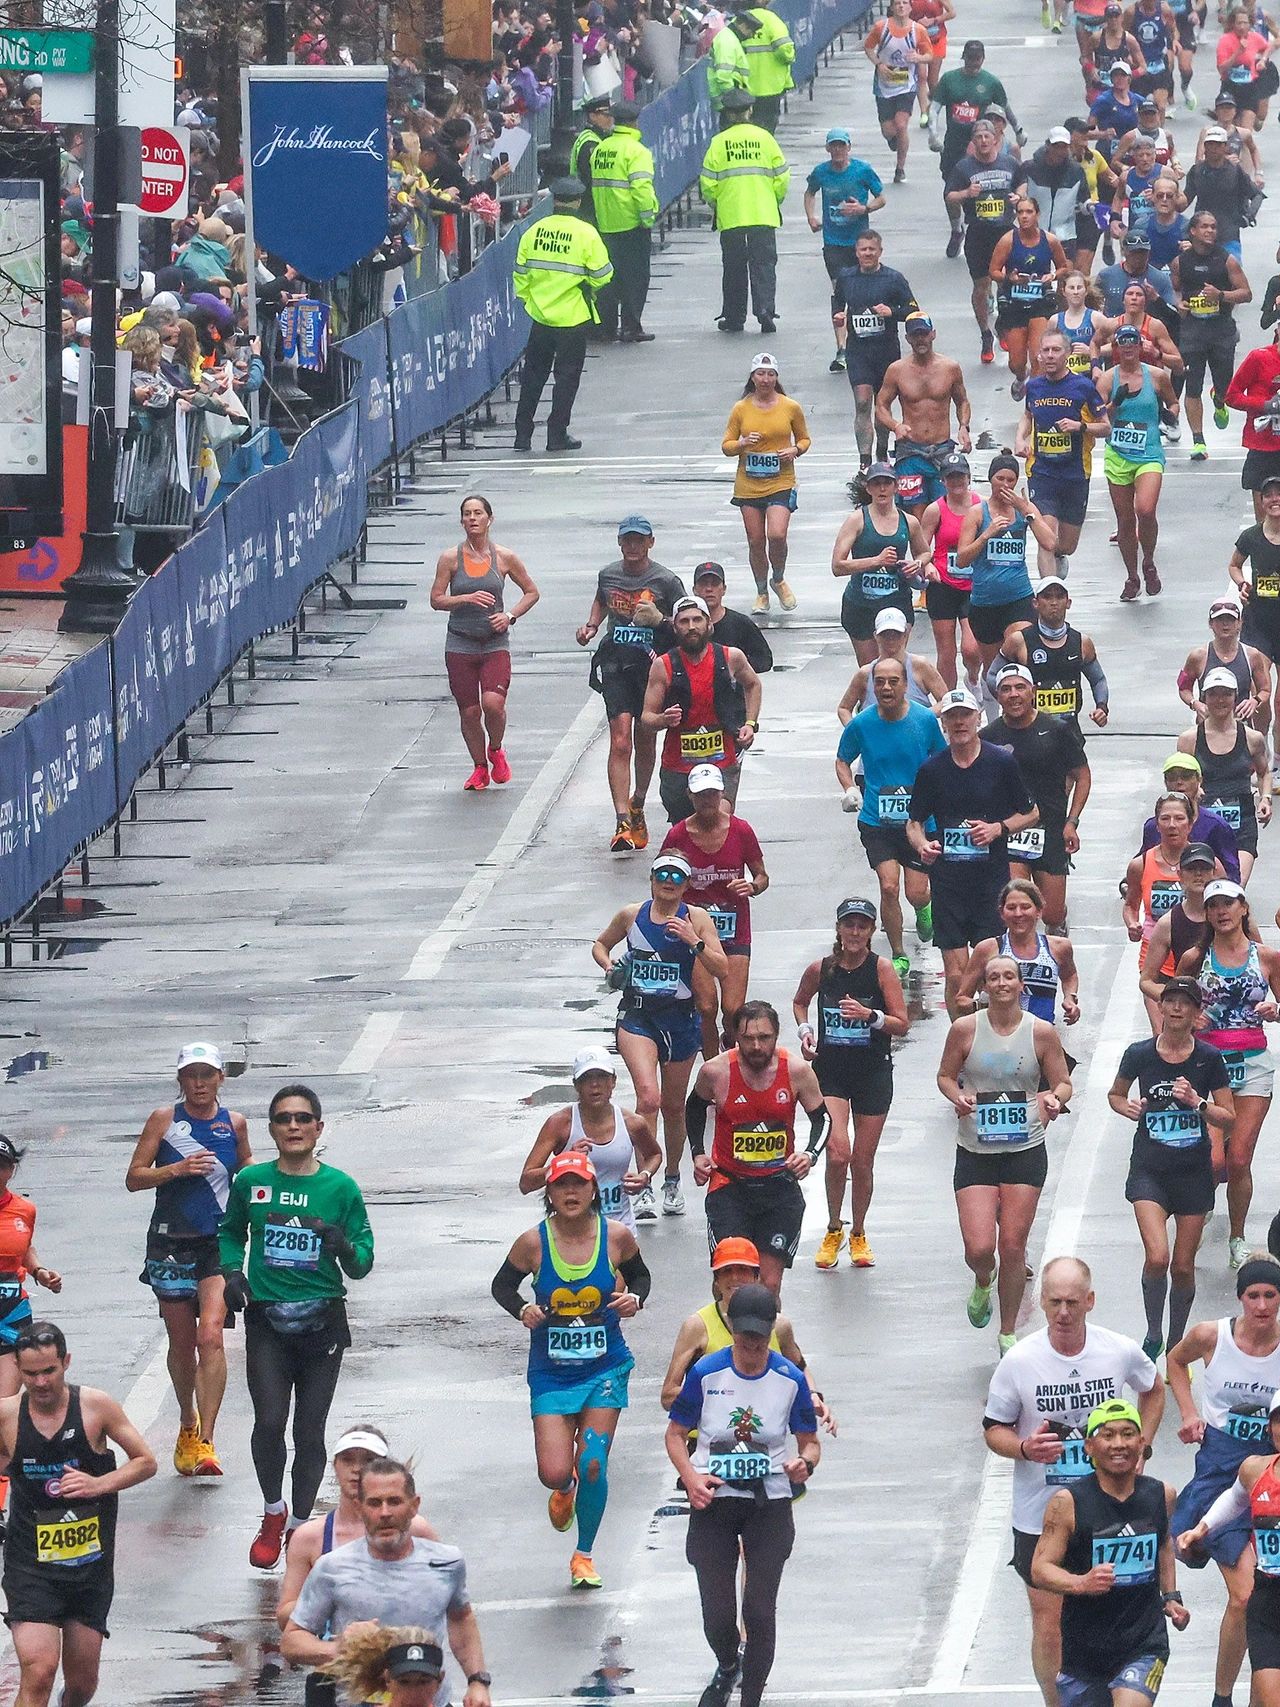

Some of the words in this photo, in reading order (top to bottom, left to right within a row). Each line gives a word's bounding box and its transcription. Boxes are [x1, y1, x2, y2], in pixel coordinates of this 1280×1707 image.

[52, 47, 66, 57] PVT
[52, 57, 66, 67] WAY
[253, 123, 306, 167] John
[304, 122, 385, 163] Hancock
[725, 140, 761, 151] Boston
[153, 146, 178, 162] NOT
[726, 150, 762, 162] Police
[141, 181, 174, 197] NTER
[535, 227, 573, 243] Boston
[533, 239, 571, 255] Police
[1034, 397, 1073, 408] SWEDEN
[1112, 427, 1146, 445] 16297
[746, 454, 780, 467] 18465
[13, 539, 26, 549] 83
[1038, 691, 1075, 708] 31501
[632, 962, 679, 981] 23055
[978, 1106, 1028, 1126] 18153
[279, 1191, 309, 1209] EIJI
[265, 1228, 318, 1253] 22861
[1035, 1382, 1081, 1397] ARIZONA
[1083, 1376, 1115, 1392] STATE
[1223, 1381, 1249, 1391] FLEET
[1036, 1396, 1067, 1413] SUN
[1069, 1389, 1115, 1411] DEVILS
[710, 1458, 771, 1479] 21983
[39, 1524, 98, 1551] 24682
[1094, 1539, 1155, 1565] 17741
